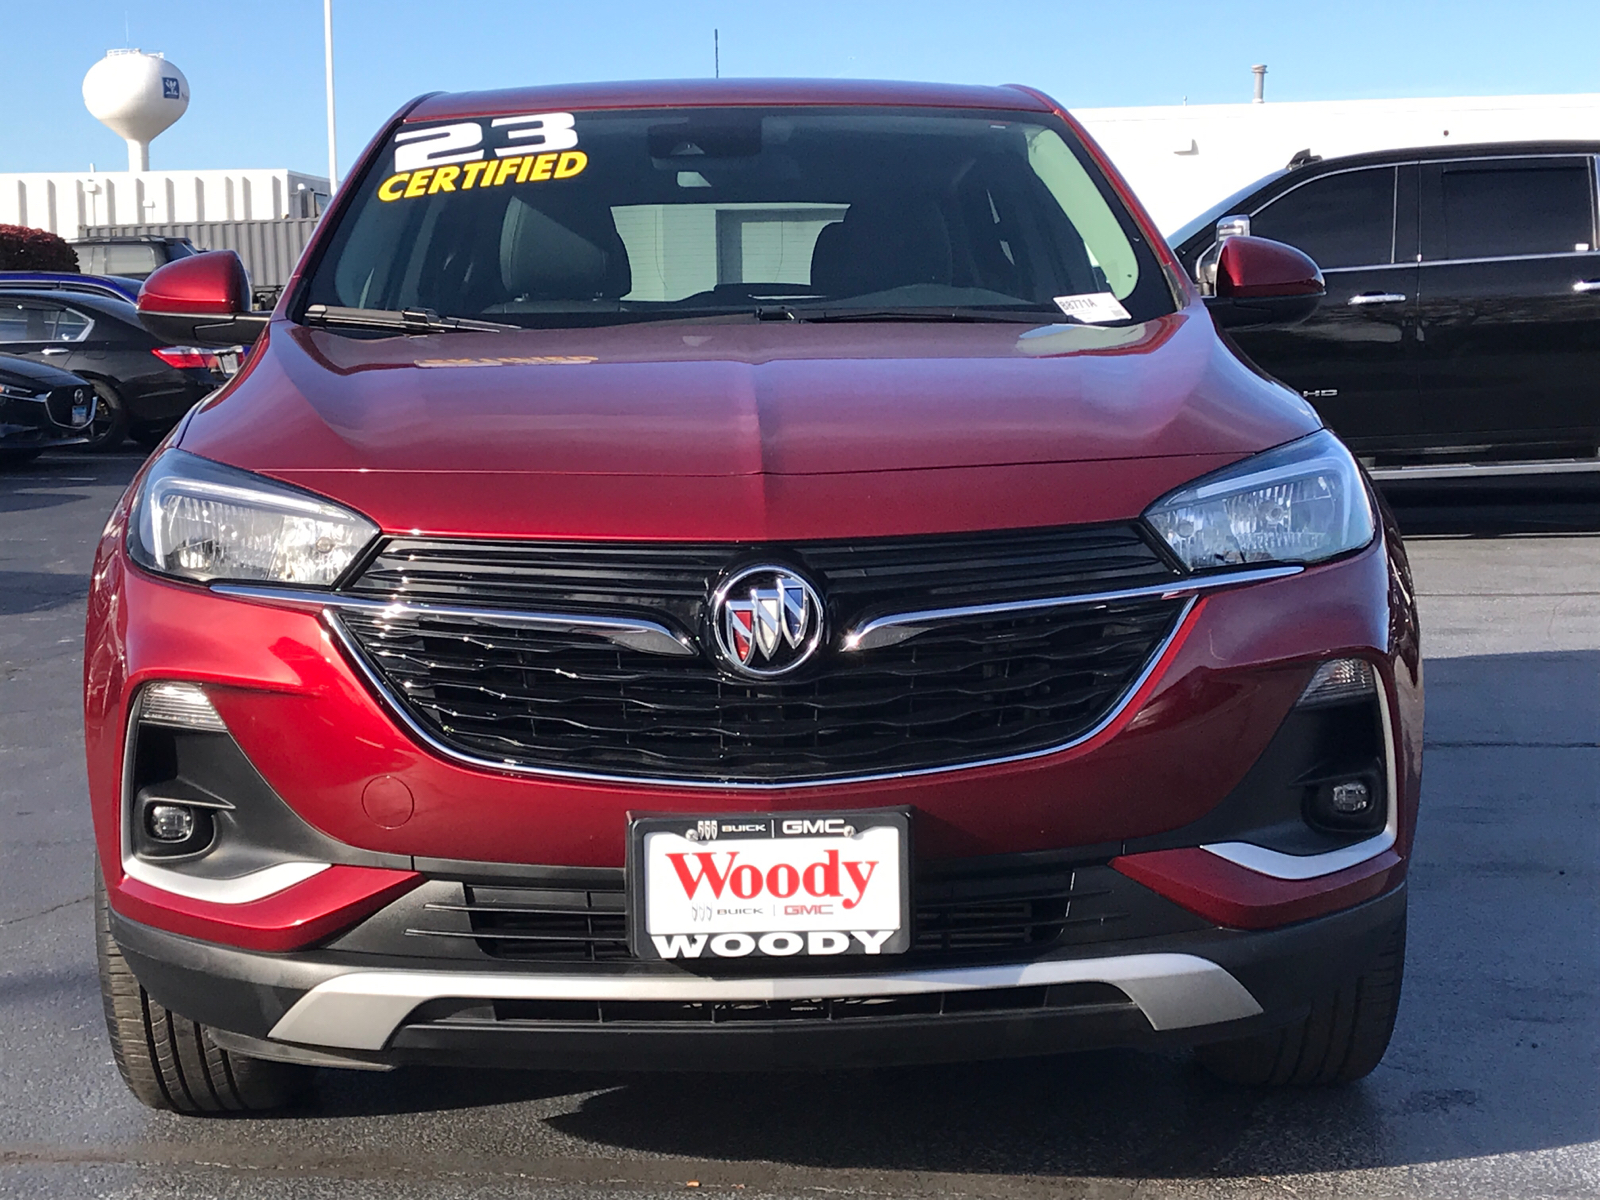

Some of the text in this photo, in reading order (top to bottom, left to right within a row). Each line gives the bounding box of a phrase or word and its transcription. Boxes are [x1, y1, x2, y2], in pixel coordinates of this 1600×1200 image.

[395, 112, 579, 173] 23
[377, 151, 588, 202] CERTIFIED
[1303, 389, 1338, 397] HD
[722, 819, 845, 834] BUICK GMC
[665, 849, 879, 909] Woody
[717, 904, 834, 915] BUICK GMC
[651, 930, 895, 959] WOODY
